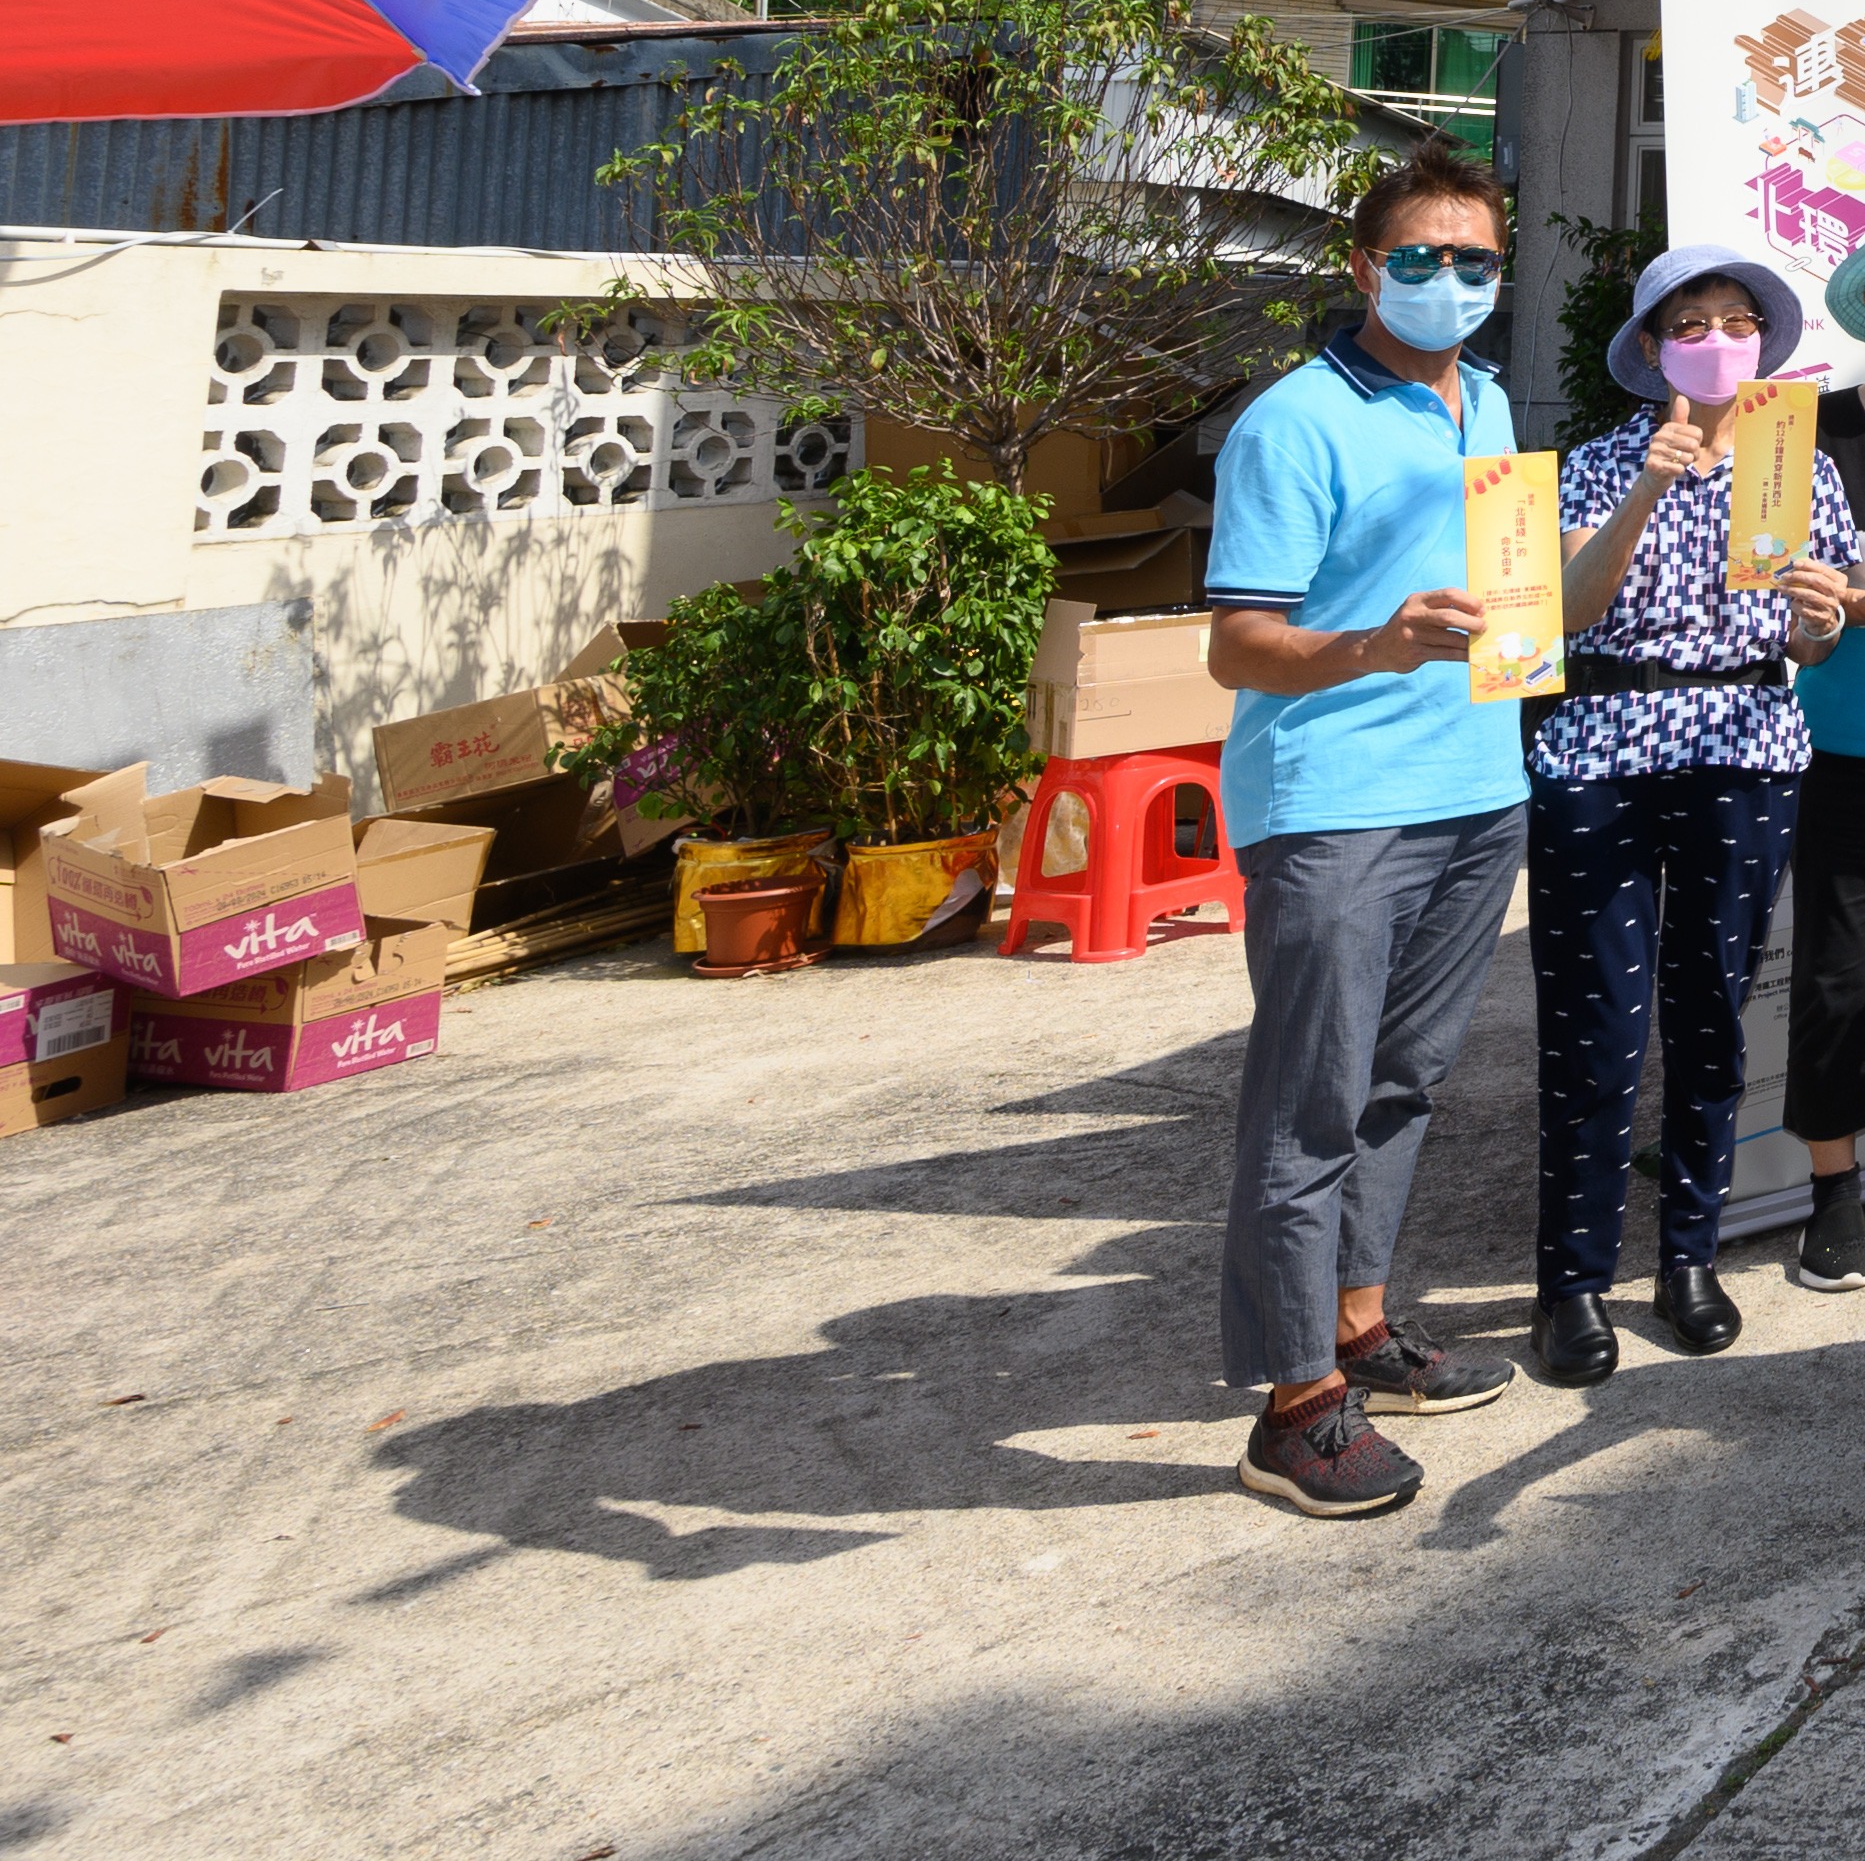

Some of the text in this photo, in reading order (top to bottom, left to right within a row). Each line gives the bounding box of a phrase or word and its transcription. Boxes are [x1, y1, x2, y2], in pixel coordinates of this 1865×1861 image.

[1771, 420, 1786, 508] 約12分鐘貫穿新界西北
[1501, 536, 1512, 578] 命名由來
[429, 731, 500, 769] 霸王花
[57, 910, 102, 958] vita
[112, 933, 163, 978] vita
[224, 912, 319, 959] vita
[204, 1029, 274, 1072] vita
[331, 1013, 405, 1059] vita
